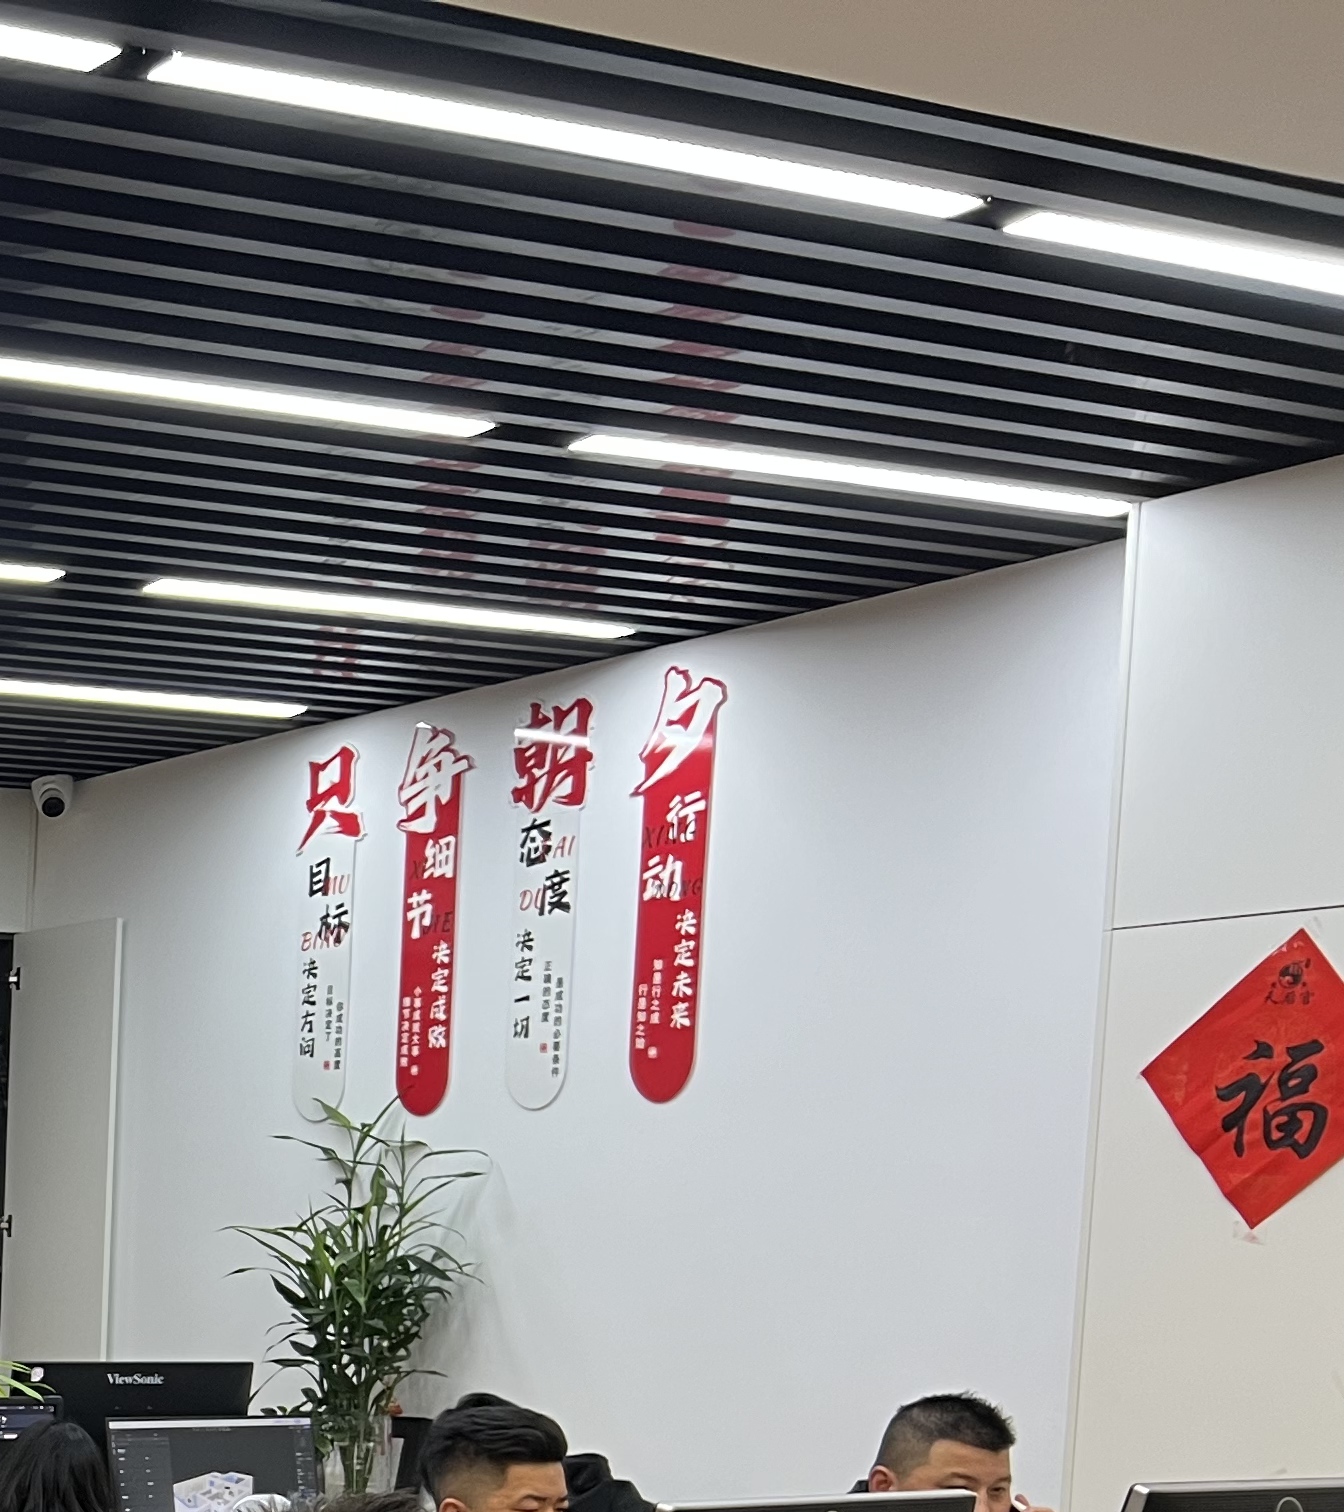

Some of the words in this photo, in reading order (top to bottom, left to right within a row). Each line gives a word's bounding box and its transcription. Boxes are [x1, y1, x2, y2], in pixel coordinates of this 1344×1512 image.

[298, 746, 361, 849] 只
[399, 722, 475, 834] 争
[512, 697, 593, 813] 朝
[630, 666, 726, 797] 夕
[308, 857, 350, 945] 目标
[406, 836, 456, 939] 细节
[519, 817, 572, 917] 态度
[643, 791, 706, 902] 行动
[299, 957, 319, 1058] 决定方向
[428, 939, 451, 1049] 决定成败
[513, 928, 535, 1040] 决定一切
[669, 908, 698, 1030] 决定未来
[1215, 1039, 1328, 1160] 福
[106, 1373, 165, 1385] ViewSonic
